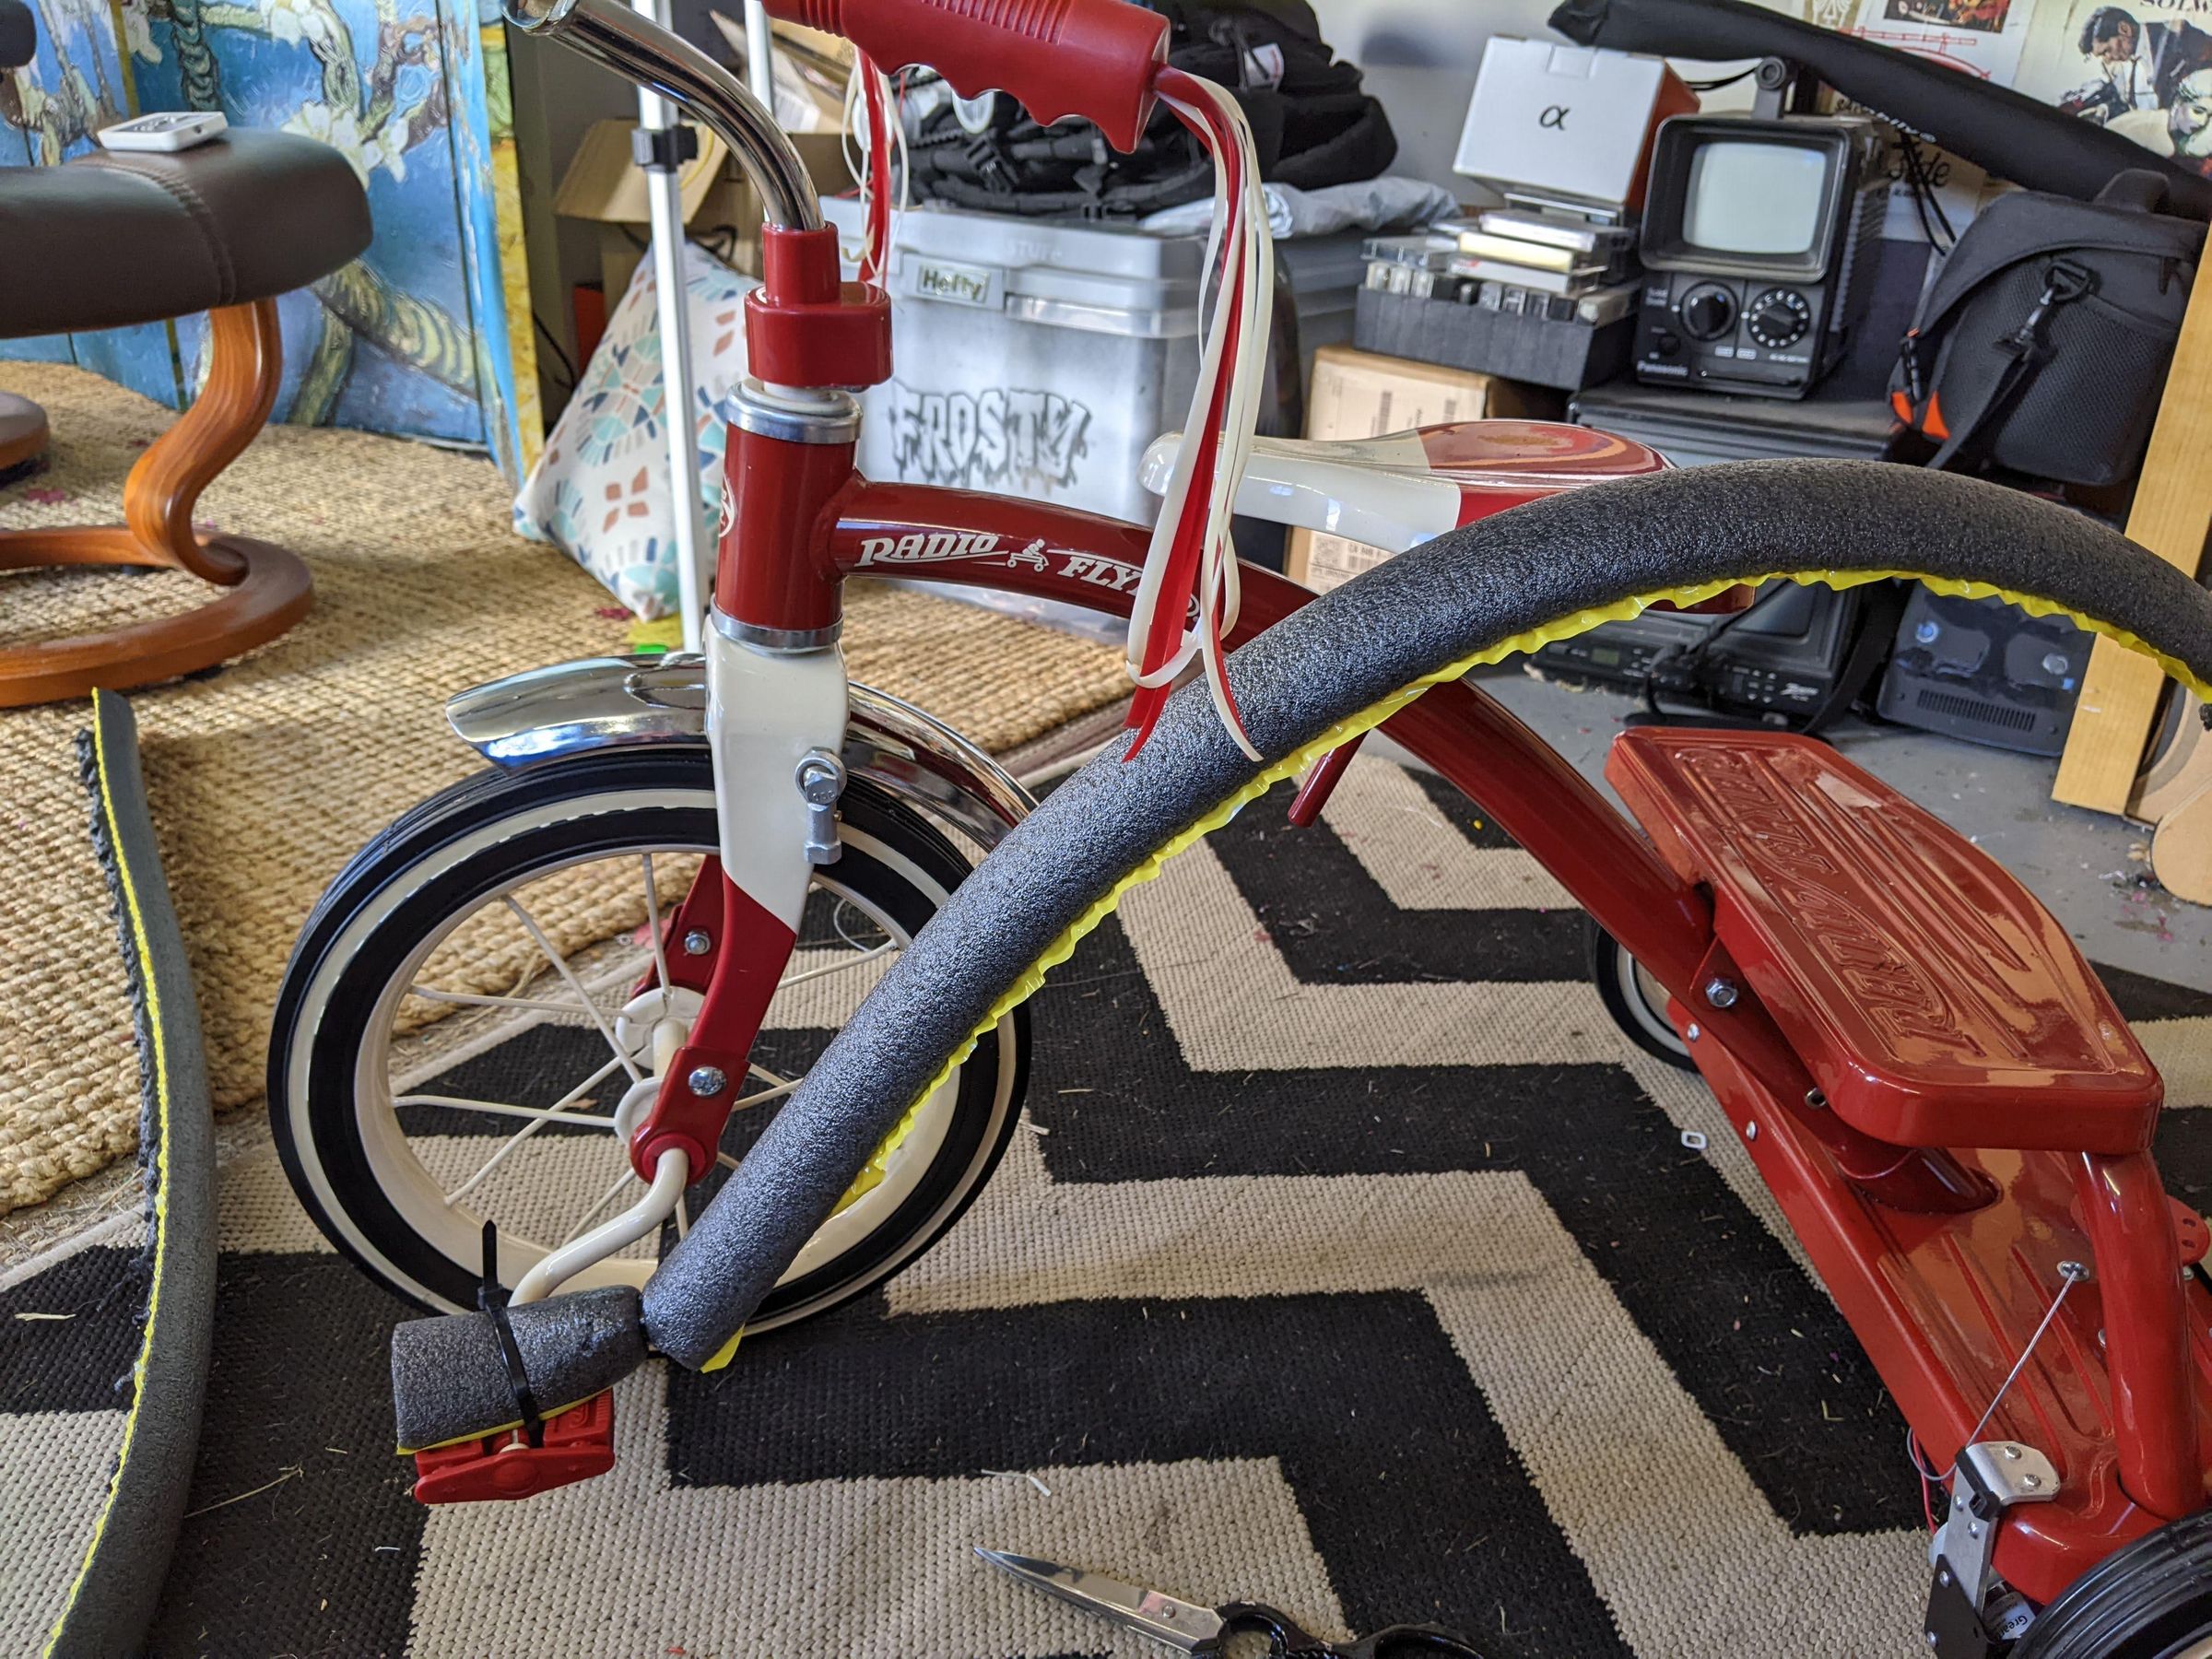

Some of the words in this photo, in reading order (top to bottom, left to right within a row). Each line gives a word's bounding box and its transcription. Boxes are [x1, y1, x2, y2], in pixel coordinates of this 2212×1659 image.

[923, 268, 983, 302] Hefty
[888, 378, 1093, 496] FROSTY
[853, 533, 1000, 568] RADIO
[1057, 556, 1143, 597] FLY
